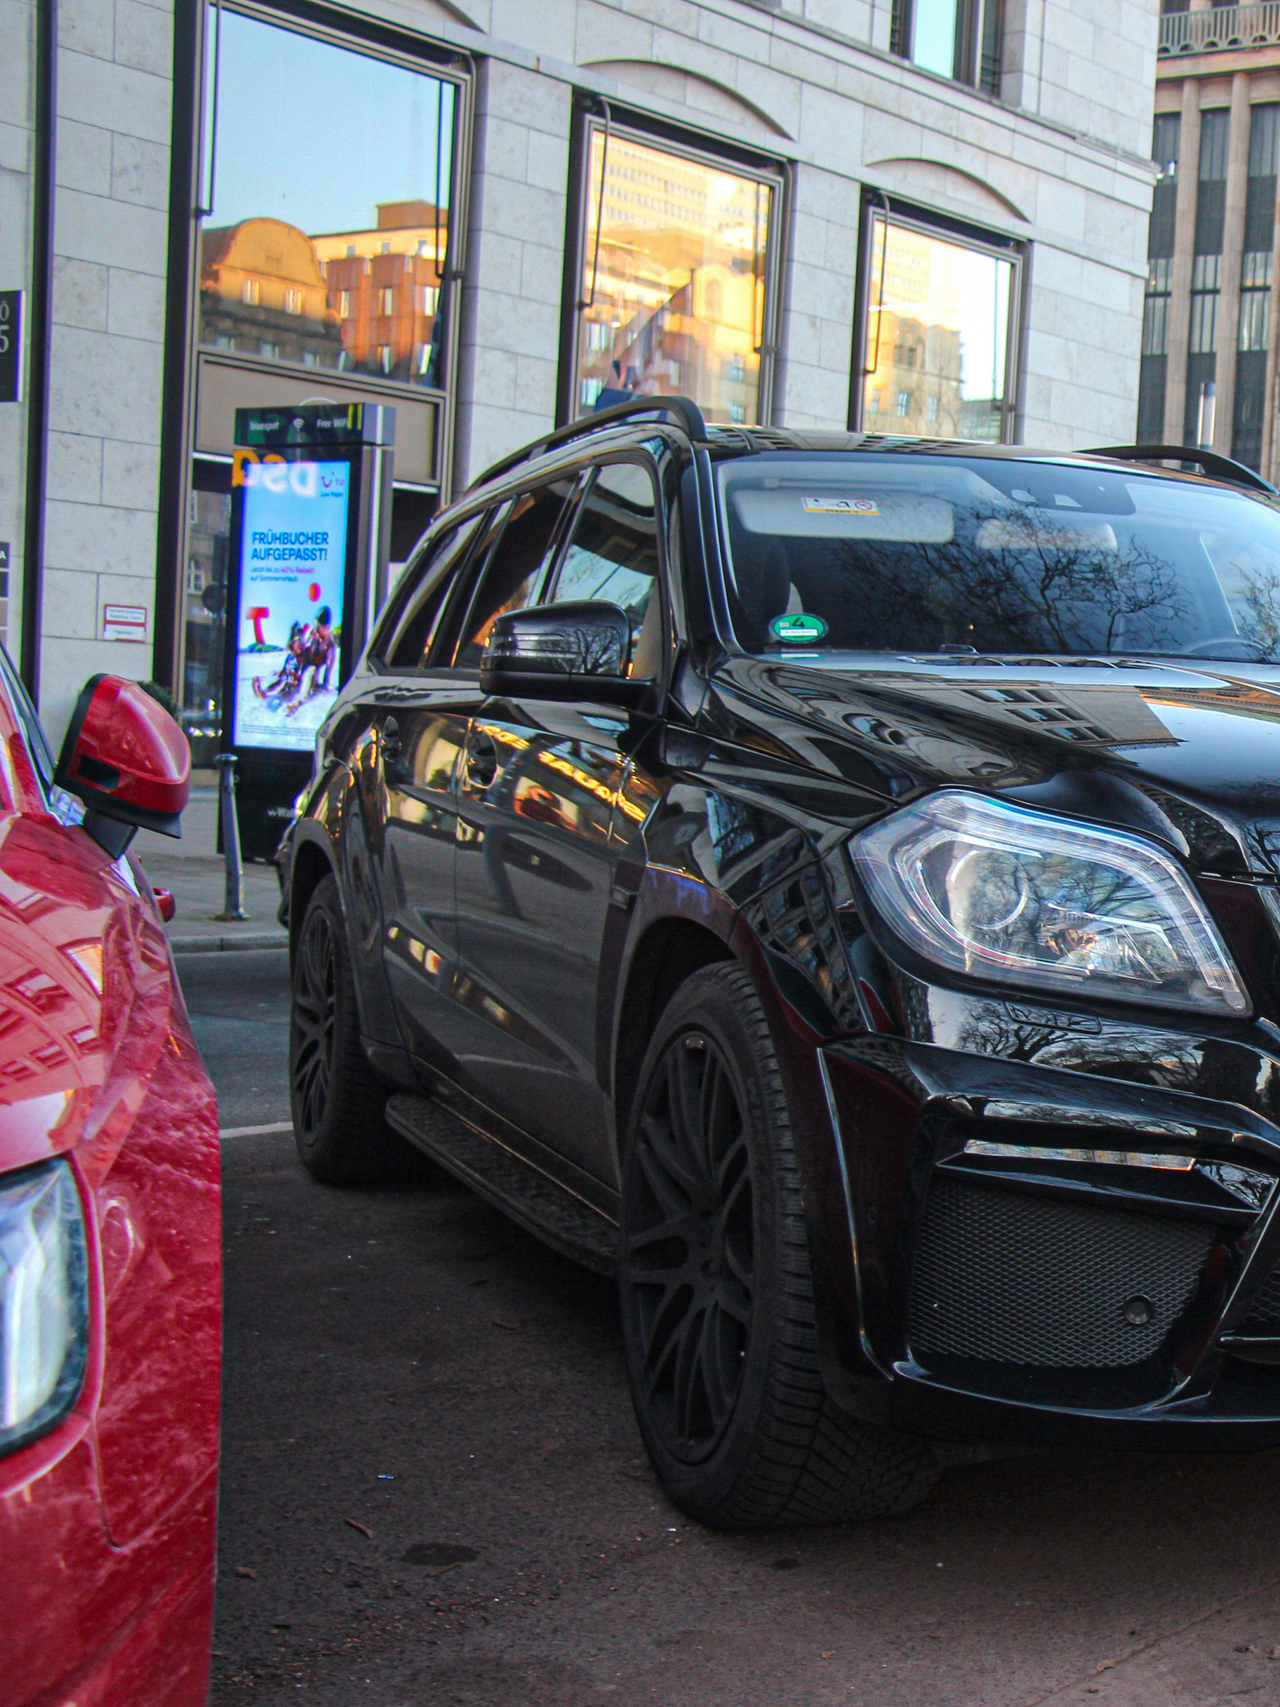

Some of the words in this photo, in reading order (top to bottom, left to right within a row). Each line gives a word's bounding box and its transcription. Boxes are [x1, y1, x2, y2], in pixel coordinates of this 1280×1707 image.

[317, 418, 332, 428] Free
[251, 528, 329, 545] FRÜHBUCHER
[251, 547, 328, 561] AUFGEPASST!
[792, 616, 806, 629] 4
